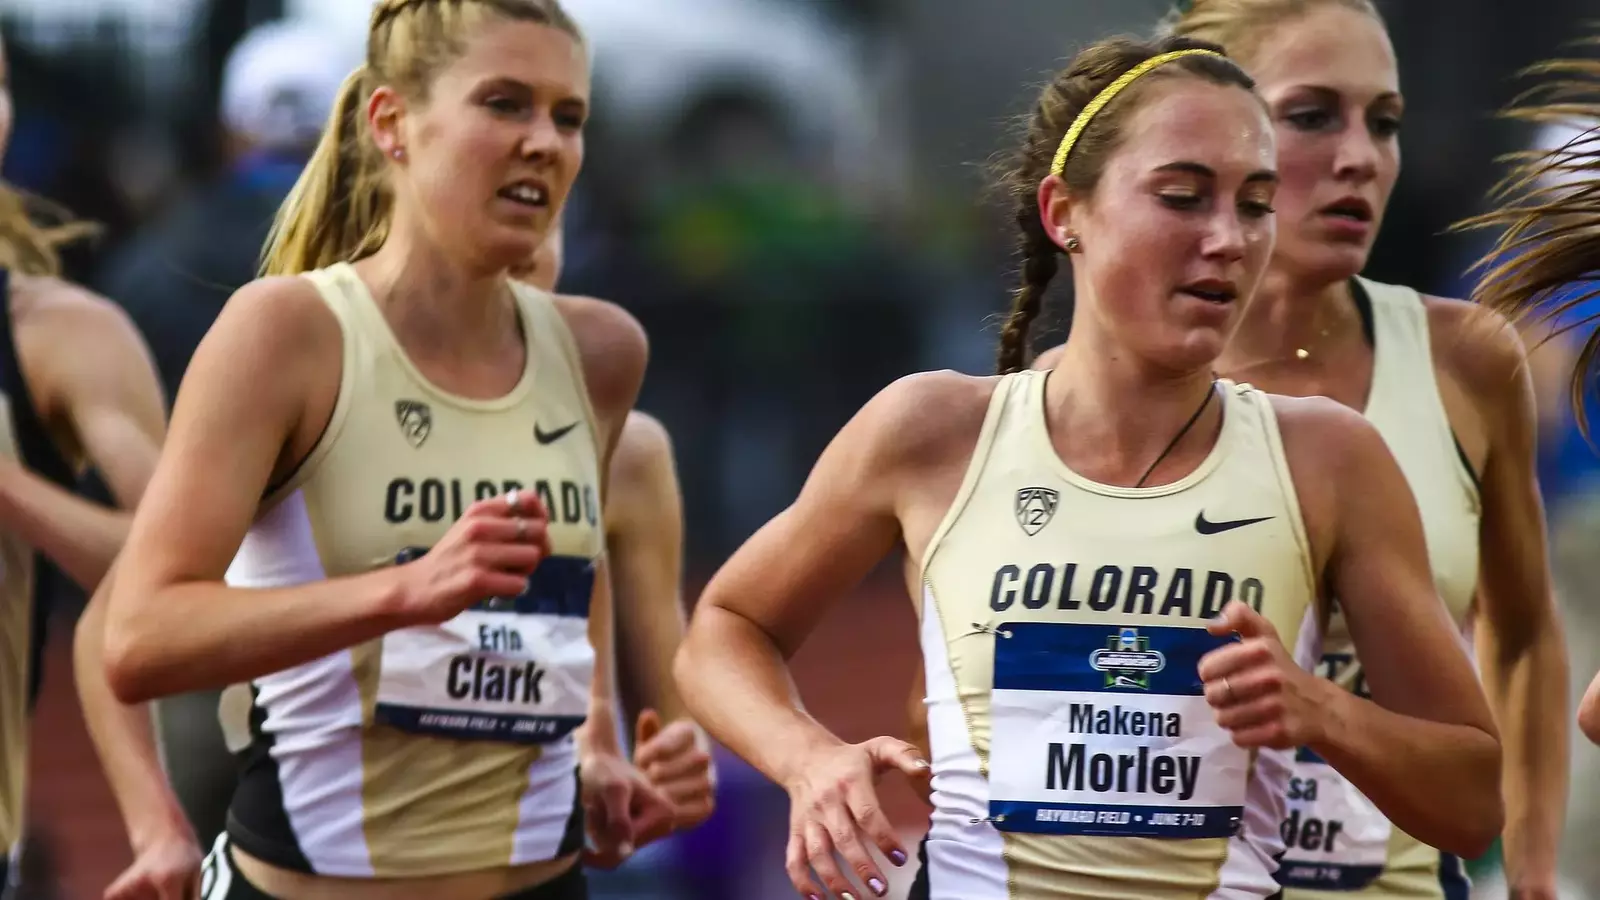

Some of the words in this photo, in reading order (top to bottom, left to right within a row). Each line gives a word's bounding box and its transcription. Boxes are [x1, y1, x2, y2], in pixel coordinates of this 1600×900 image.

[1023, 508, 1044, 525] 12
[988, 563, 1264, 619] COLORADO
[478, 624, 523, 651] Erin
[446, 655, 545, 704] Clark
[1069, 703, 1181, 738] Makena
[1045, 743, 1202, 800] Morley
[1035, 808, 1096, 824] HAYWARD
[1096, 811, 1131, 825] FIELD
[1147, 812, 1181, 826] JUNE
[1182, 813, 1206, 826] 7-10
